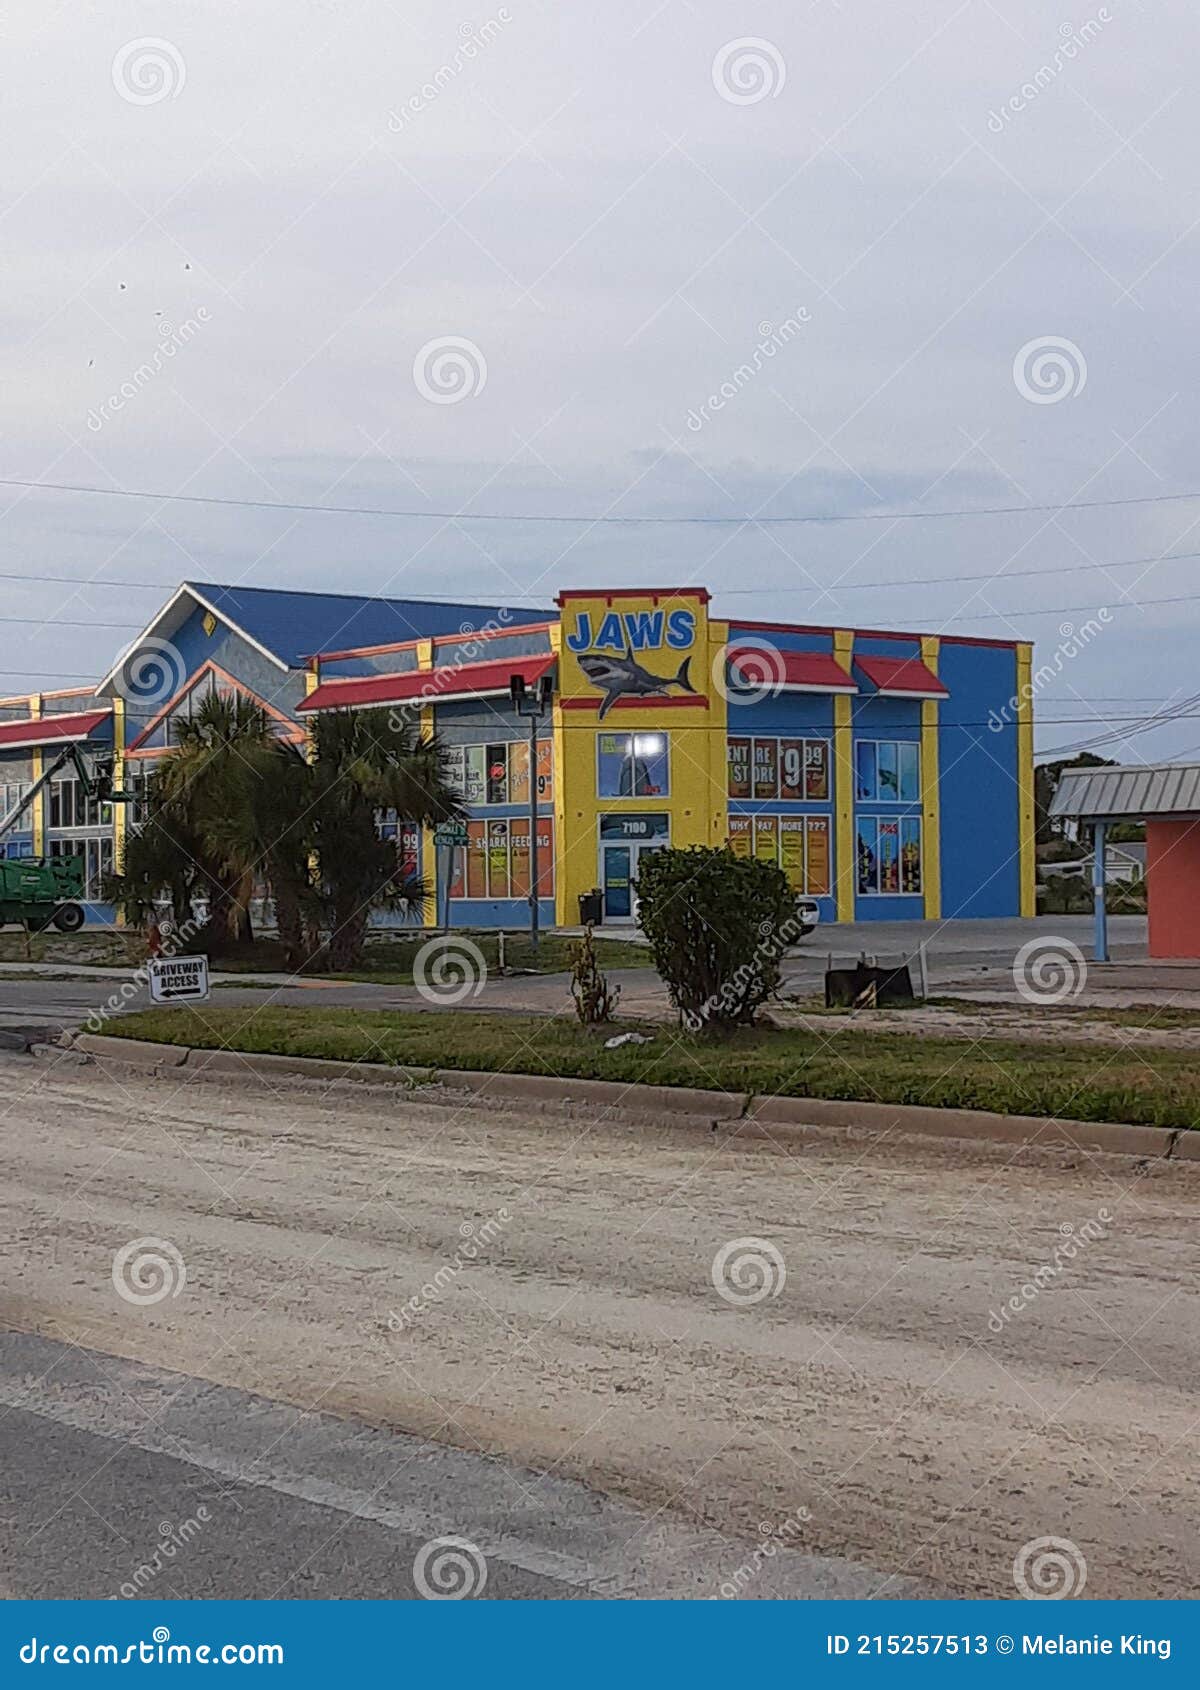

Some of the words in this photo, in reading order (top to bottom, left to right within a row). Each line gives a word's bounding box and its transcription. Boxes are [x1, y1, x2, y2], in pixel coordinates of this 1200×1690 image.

[567, 609, 696, 652] JAWS
[728, 745, 770, 764] ENTRE
[622, 821, 647, 834] 7100
[729, 820, 749, 831] WHY
[476, 837, 506, 849] SHARK
[511, 834, 550, 848] FEEDNG
[153, 962, 203, 977] DRIVEWAY
[161, 974, 199, 988] ACCESS
